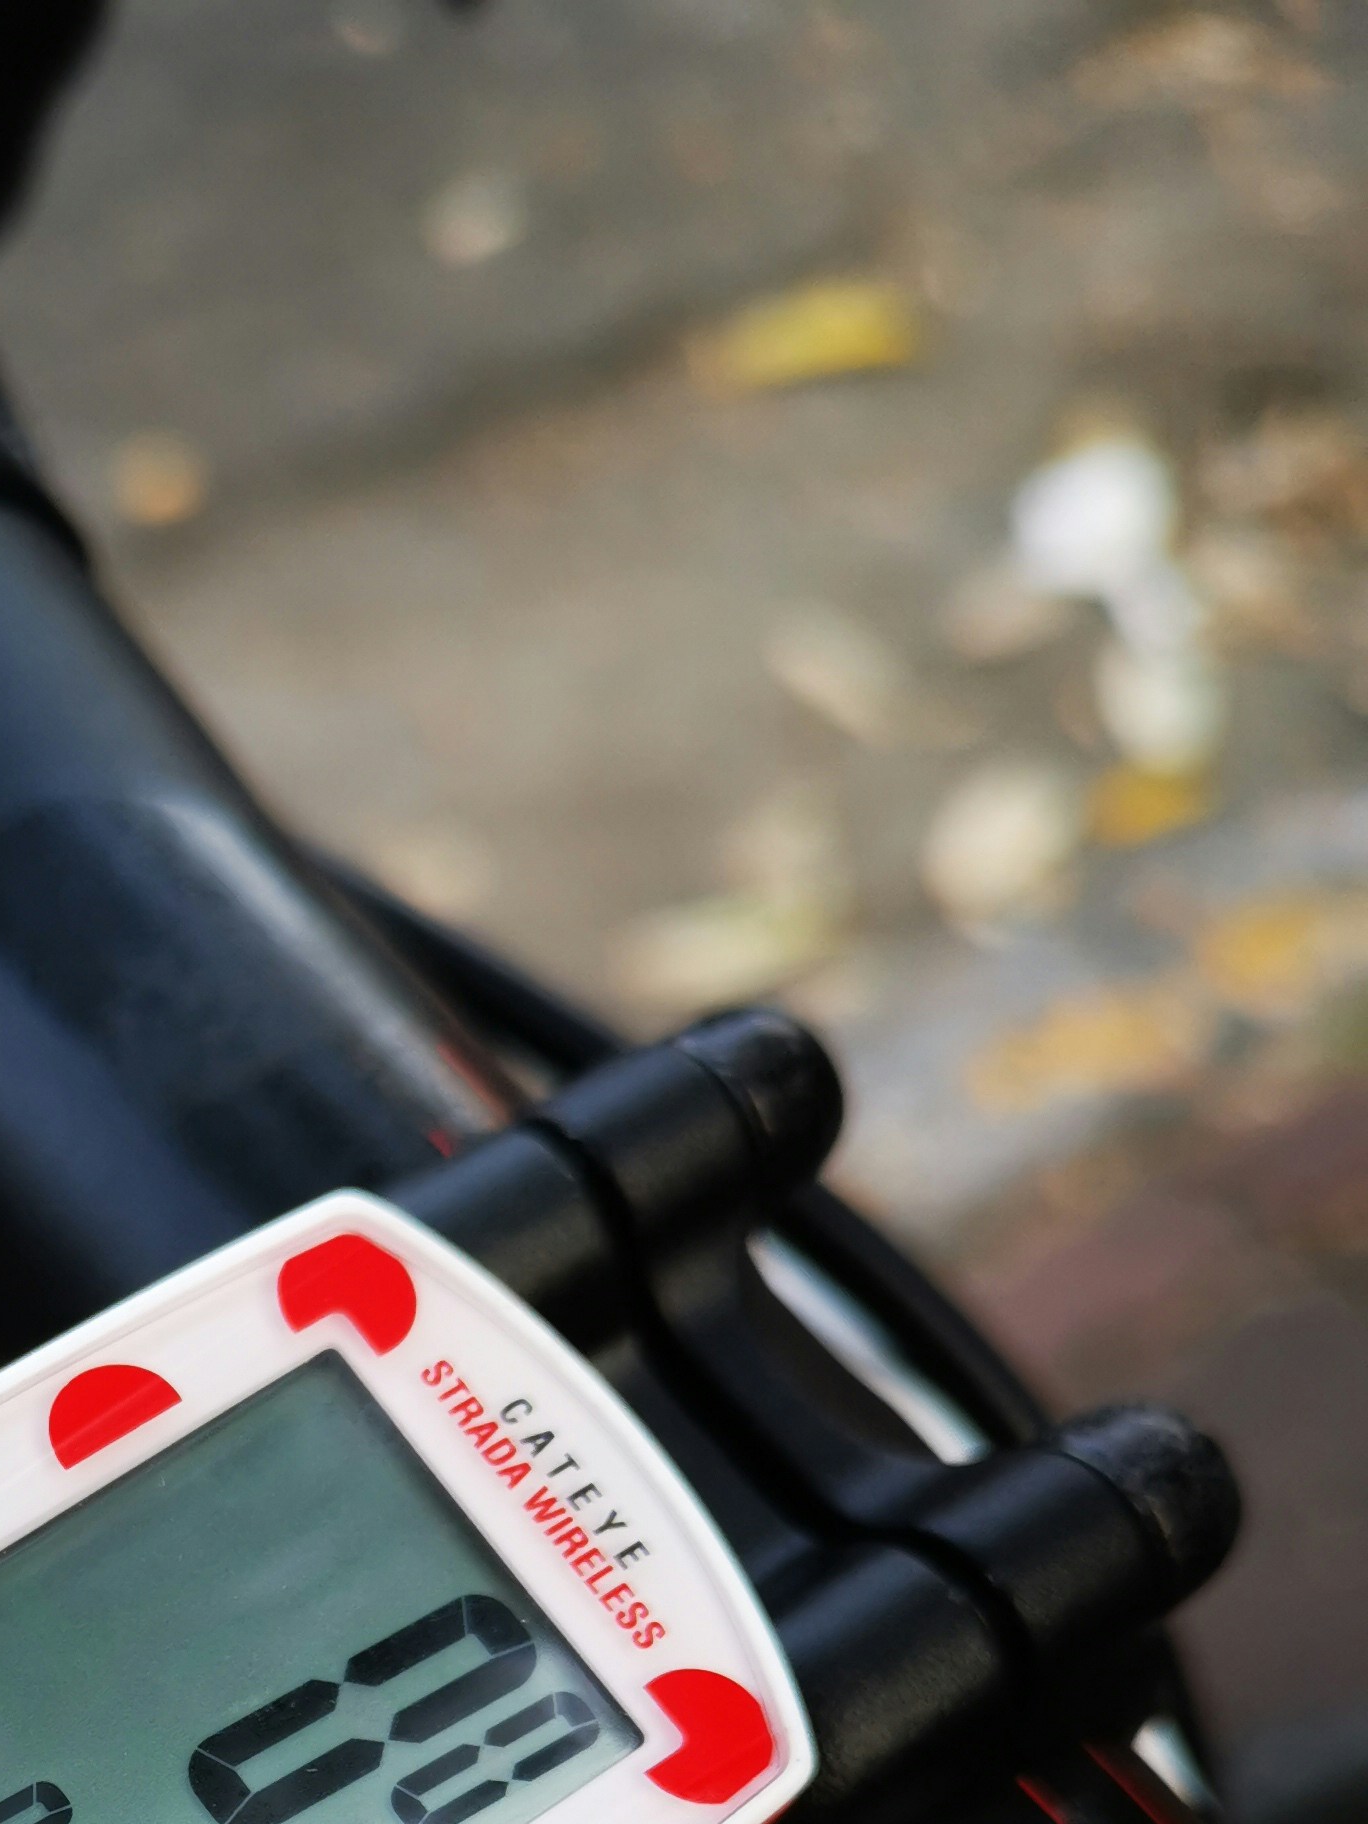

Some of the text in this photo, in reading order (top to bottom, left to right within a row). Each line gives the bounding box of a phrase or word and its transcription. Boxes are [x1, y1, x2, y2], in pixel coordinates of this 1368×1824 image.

[421, 1360, 666, 1650] STRADA WIRELESS
[500, 1398, 650, 1571] CATEYE
